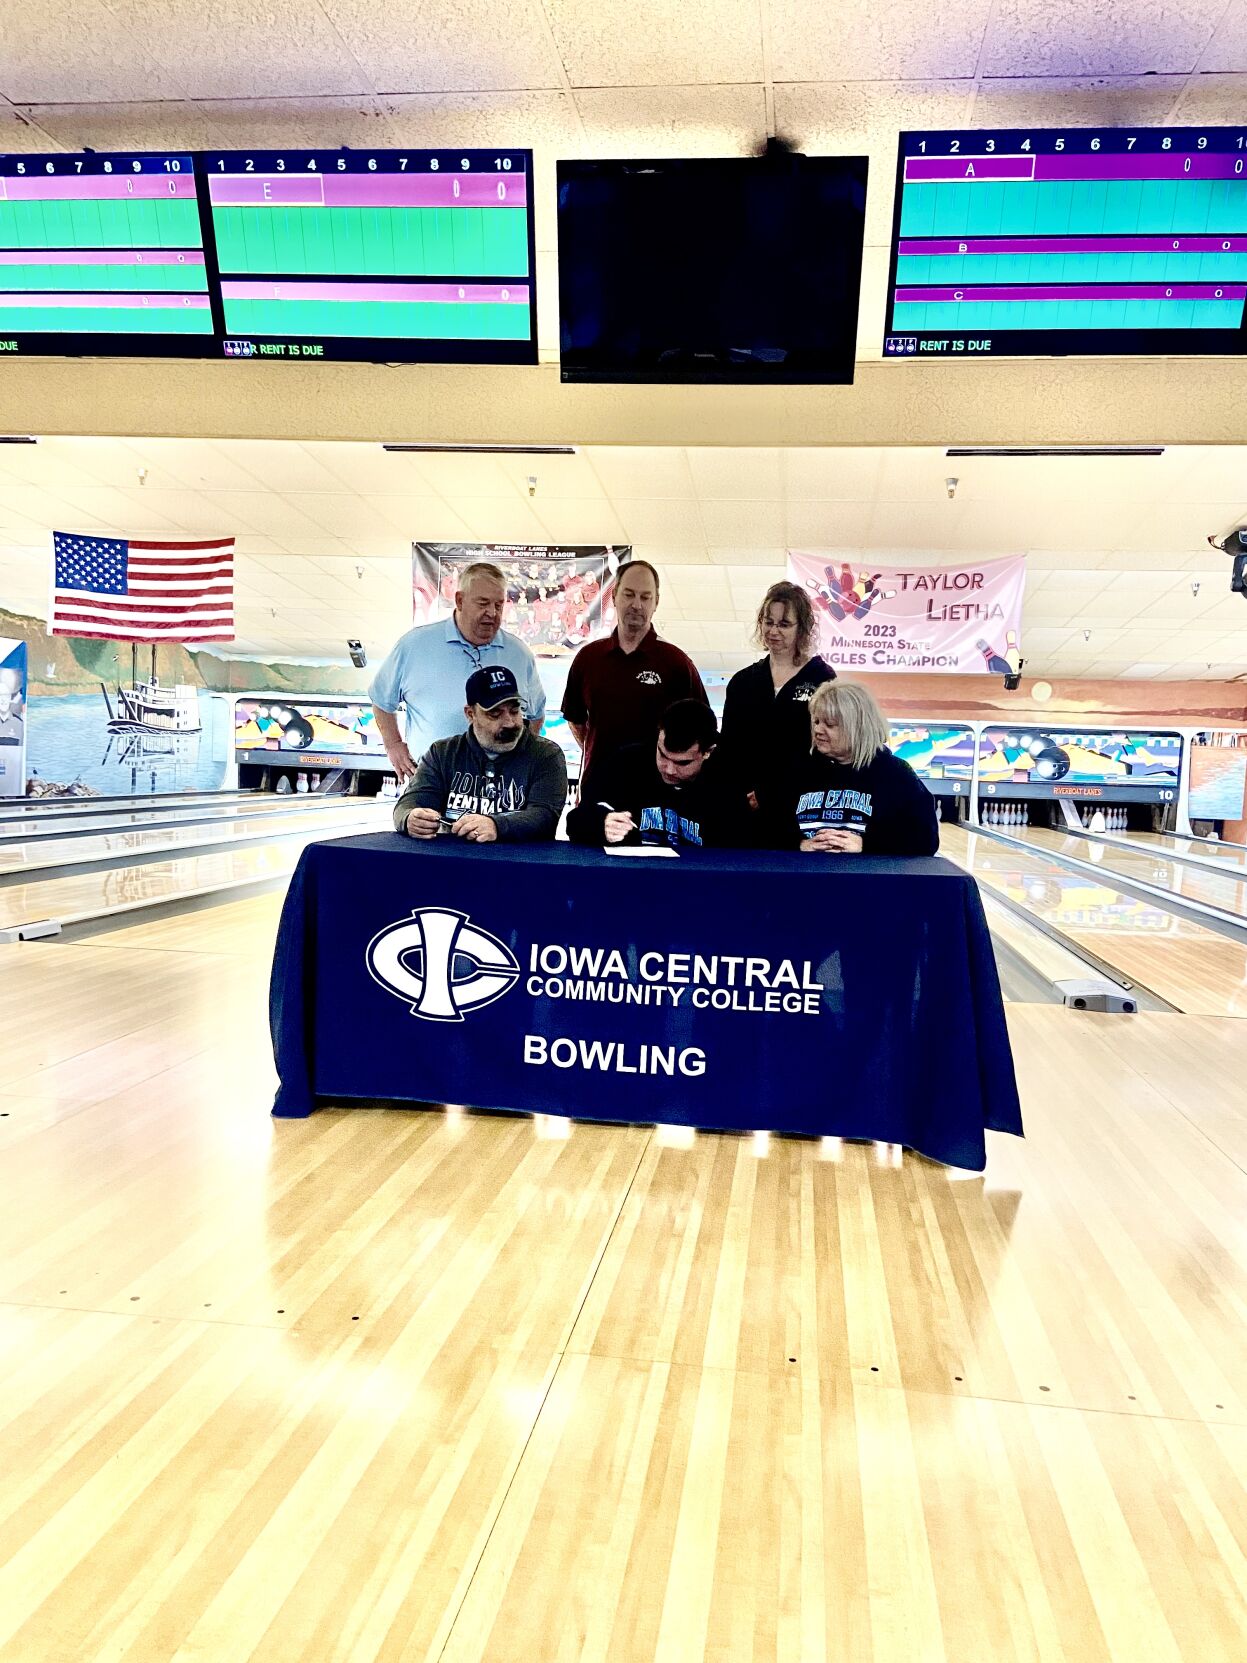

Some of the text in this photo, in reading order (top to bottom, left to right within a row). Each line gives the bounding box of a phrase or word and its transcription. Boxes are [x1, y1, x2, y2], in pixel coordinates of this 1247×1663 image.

[918, 136, 1247, 152] 1 2 3 4 5 6 7 8 9 1
[17, 160, 181, 174] 5 6 7 8 9 10
[217, 158, 512, 171] 1 2 3 4 5 6 7 8 9 10
[964, 157, 1243, 177] A 0 0
[263, 183, 272, 200] E
[497, 182, 506, 200] 0
[958, 243, 968, 252] B
[953, 291, 964, 300] C
[0, 341, 18, 351] DUE
[260, 344, 286, 355] RENT
[288, 345, 300, 355] IS
[302, 345, 324, 356] DUE
[919, 340, 950, 351] RENT
[952, 340, 965, 351] IS
[967, 340, 992, 351] DUE
[895, 573, 984, 591] TAYLOR
[864, 624, 897, 637] 2023
[830, 636, 931, 650] MINNESOTA STATE
[872, 650, 959, 667] CHAMPION
[490, 671, 506, 683] IC
[952, 782, 962, 793] 8
[987, 784, 997, 795] 9
[1158, 790, 1174, 801] 10
[796, 789, 873, 817] IOWA CENTRAL
[821, 809, 844, 820] 1966
[529, 943, 824, 991] IOWA CENTRAL
[526, 975, 820, 1015] COMMUNITY COLLEGE
[524, 1034, 706, 1077] BOWLING
